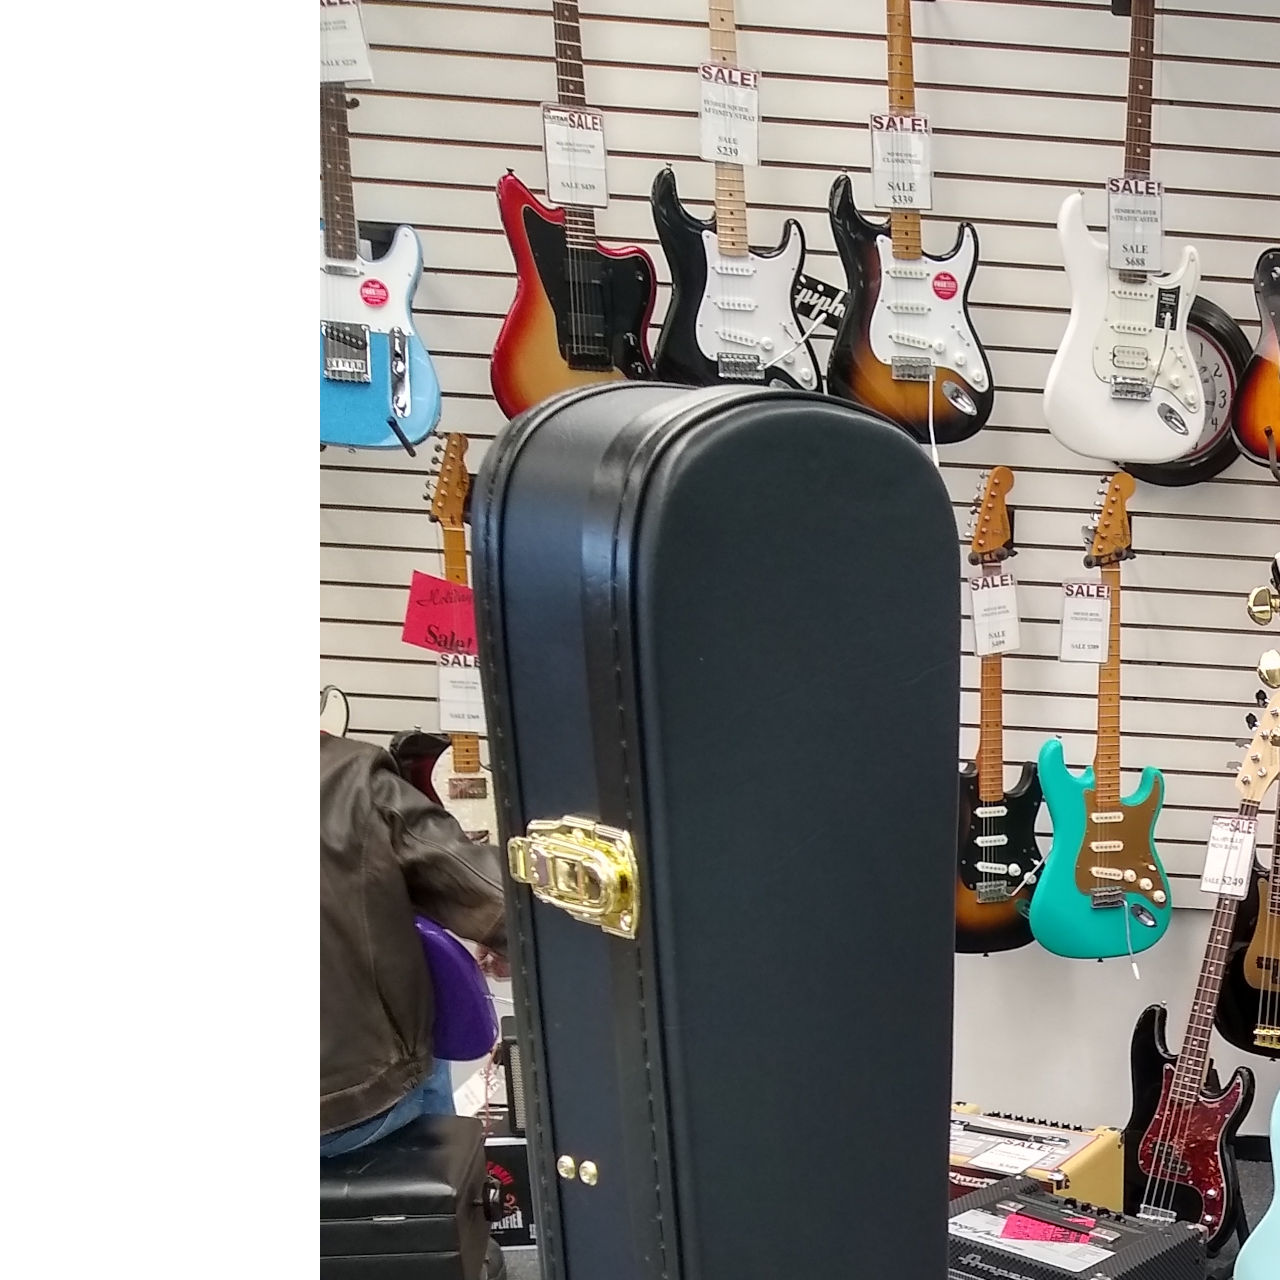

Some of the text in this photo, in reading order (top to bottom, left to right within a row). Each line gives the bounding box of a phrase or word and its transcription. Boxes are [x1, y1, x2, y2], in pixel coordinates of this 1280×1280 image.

[702, 65, 757, 88] SALE!
[568, 113, 603, 131] SALE!
[873, 116, 928, 133] SALE!
[718, 136, 738, 144] SALE
[717, 146, 738, 156] $239
[888, 182, 916, 192] SALE
[1109, 179, 1161, 196] SALE!
[892, 195, 913, 204] $339
[1122, 244, 1149, 254] SALE
[1213, 363, 1222, 378] 2
[1218, 390, 1227, 409] 3
[1211, 417, 1219, 432] 4
[971, 574, 1014, 591] SALE!
[1065, 584, 1110, 598] SALE!
[1003, 1139, 1055, 1153] SALE!
[489, 1211, 523, 1230] PLIFIER
